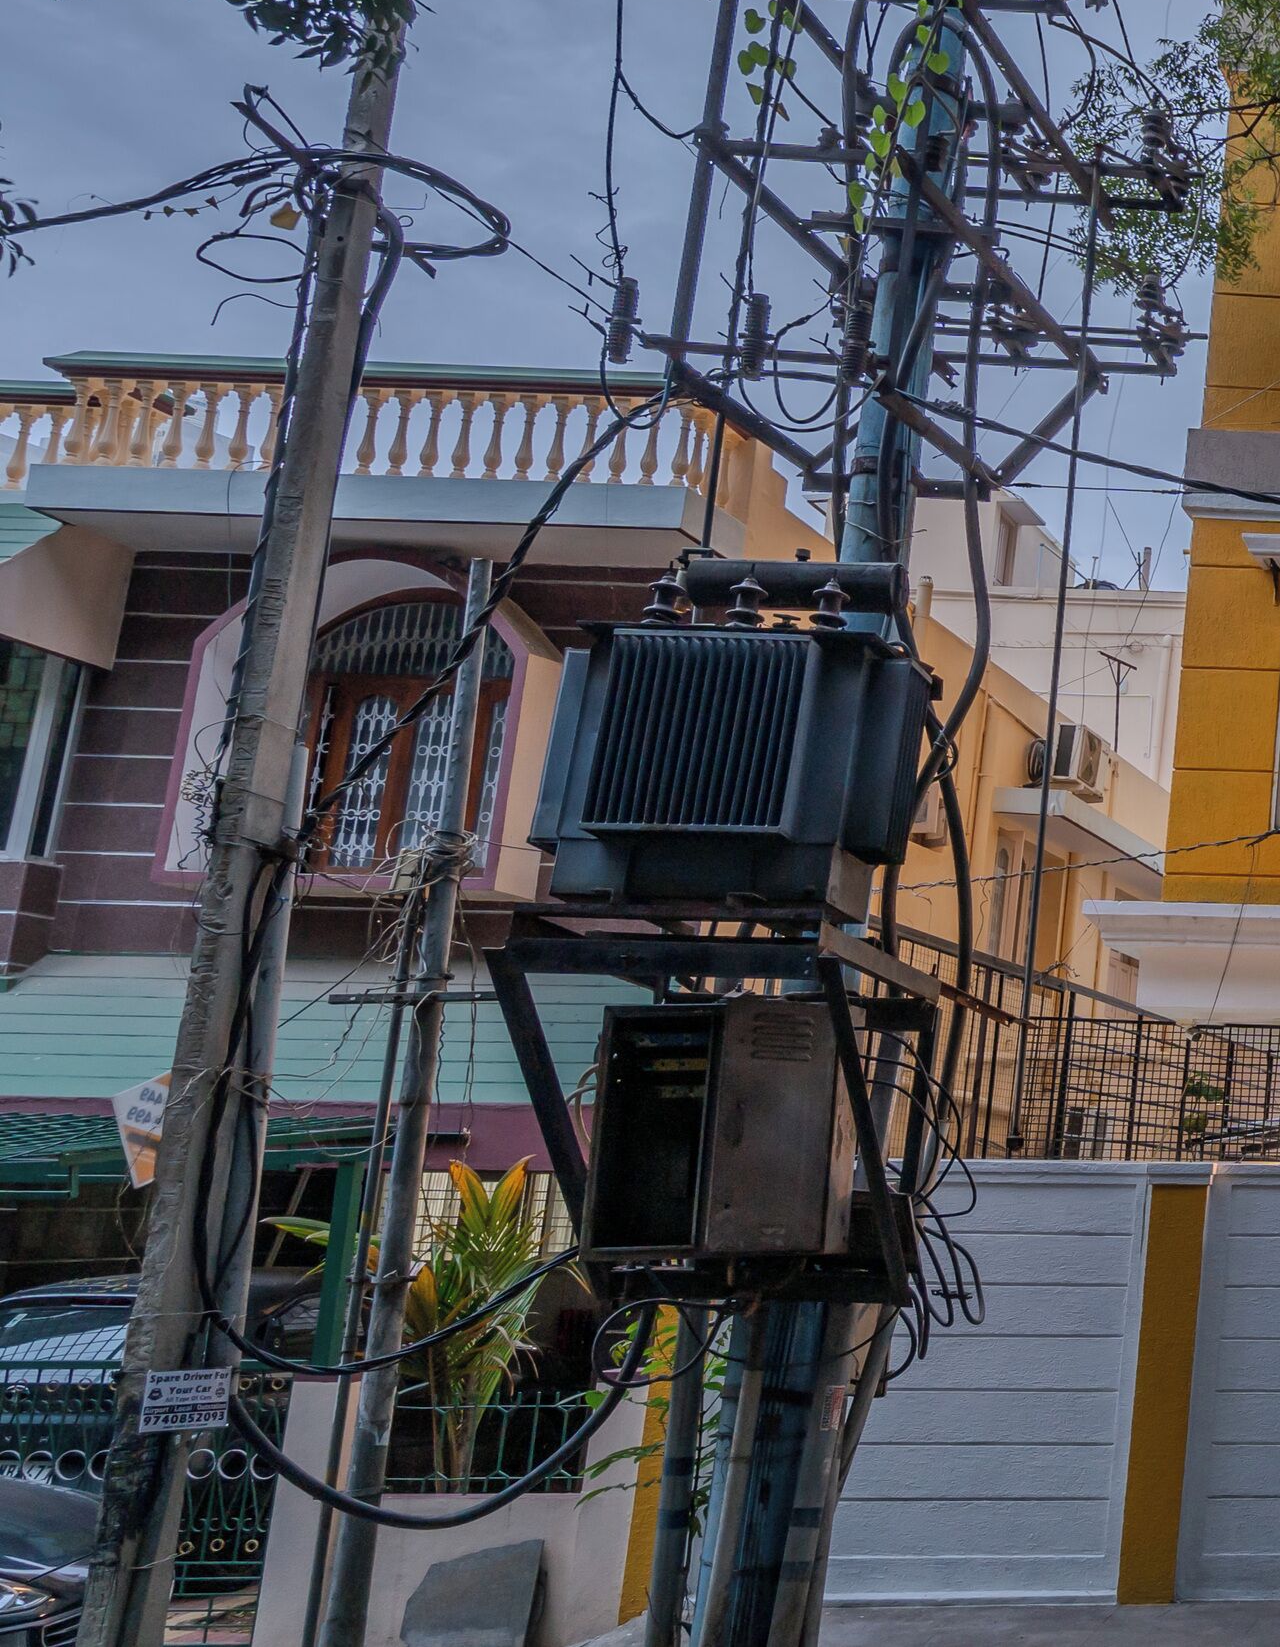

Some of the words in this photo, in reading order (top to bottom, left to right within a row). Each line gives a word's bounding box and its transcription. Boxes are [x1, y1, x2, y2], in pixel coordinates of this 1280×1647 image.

[149, 1374, 180, 1385] Spare
[183, 1372, 213, 1381] Driver
[215, 1371, 229, 1380] For
[169, 1386, 193, 1395] Your
[195, 1385, 212, 1394] Car
[143, 1411, 225, 1426] 9740852093
